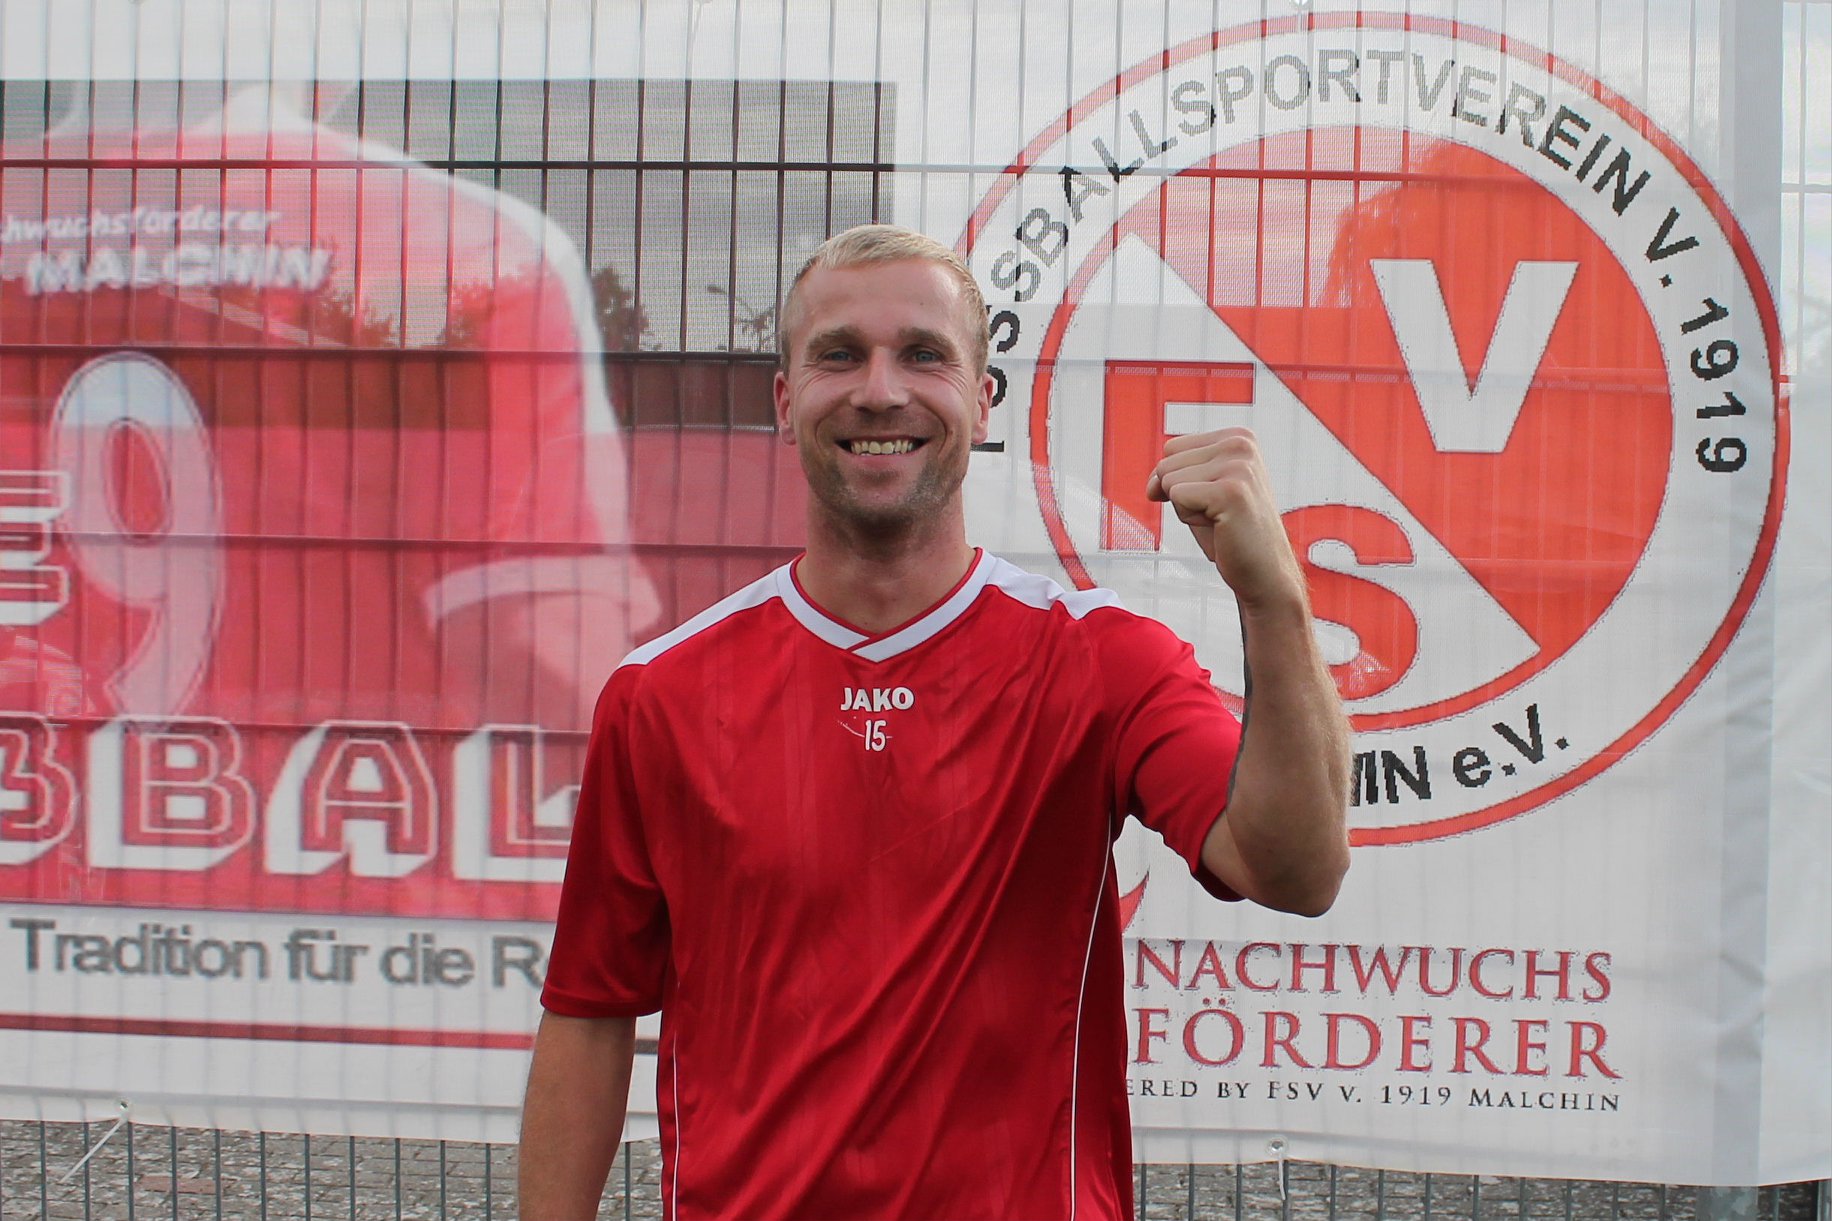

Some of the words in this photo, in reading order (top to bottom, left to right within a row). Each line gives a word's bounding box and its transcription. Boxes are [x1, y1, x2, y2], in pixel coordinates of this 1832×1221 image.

[24, 243, 332, 296] MALCHIN
[1680, 298, 1747, 473] 1919
[840, 686, 915, 712] JAKO
[865, 719, 887, 752] 15
[1452, 703, 1570, 788] e.V.
[9, 918, 269, 980] Tradition
[284, 928, 370, 984] für
[378, 931, 475, 987] die
[1131, 939, 1614, 1003] NACHWUCHS
[1132, 997, 1624, 1081] FÖRDERER
[1216, 1080, 1250, 1099] BY
[1267, 1081, 1324, 1101] FSV
[1339, 1085, 1361, 1103] V.
[1381, 1085, 1451, 1107] 1919
[1468, 1088, 1620, 1112] MALCHIN
